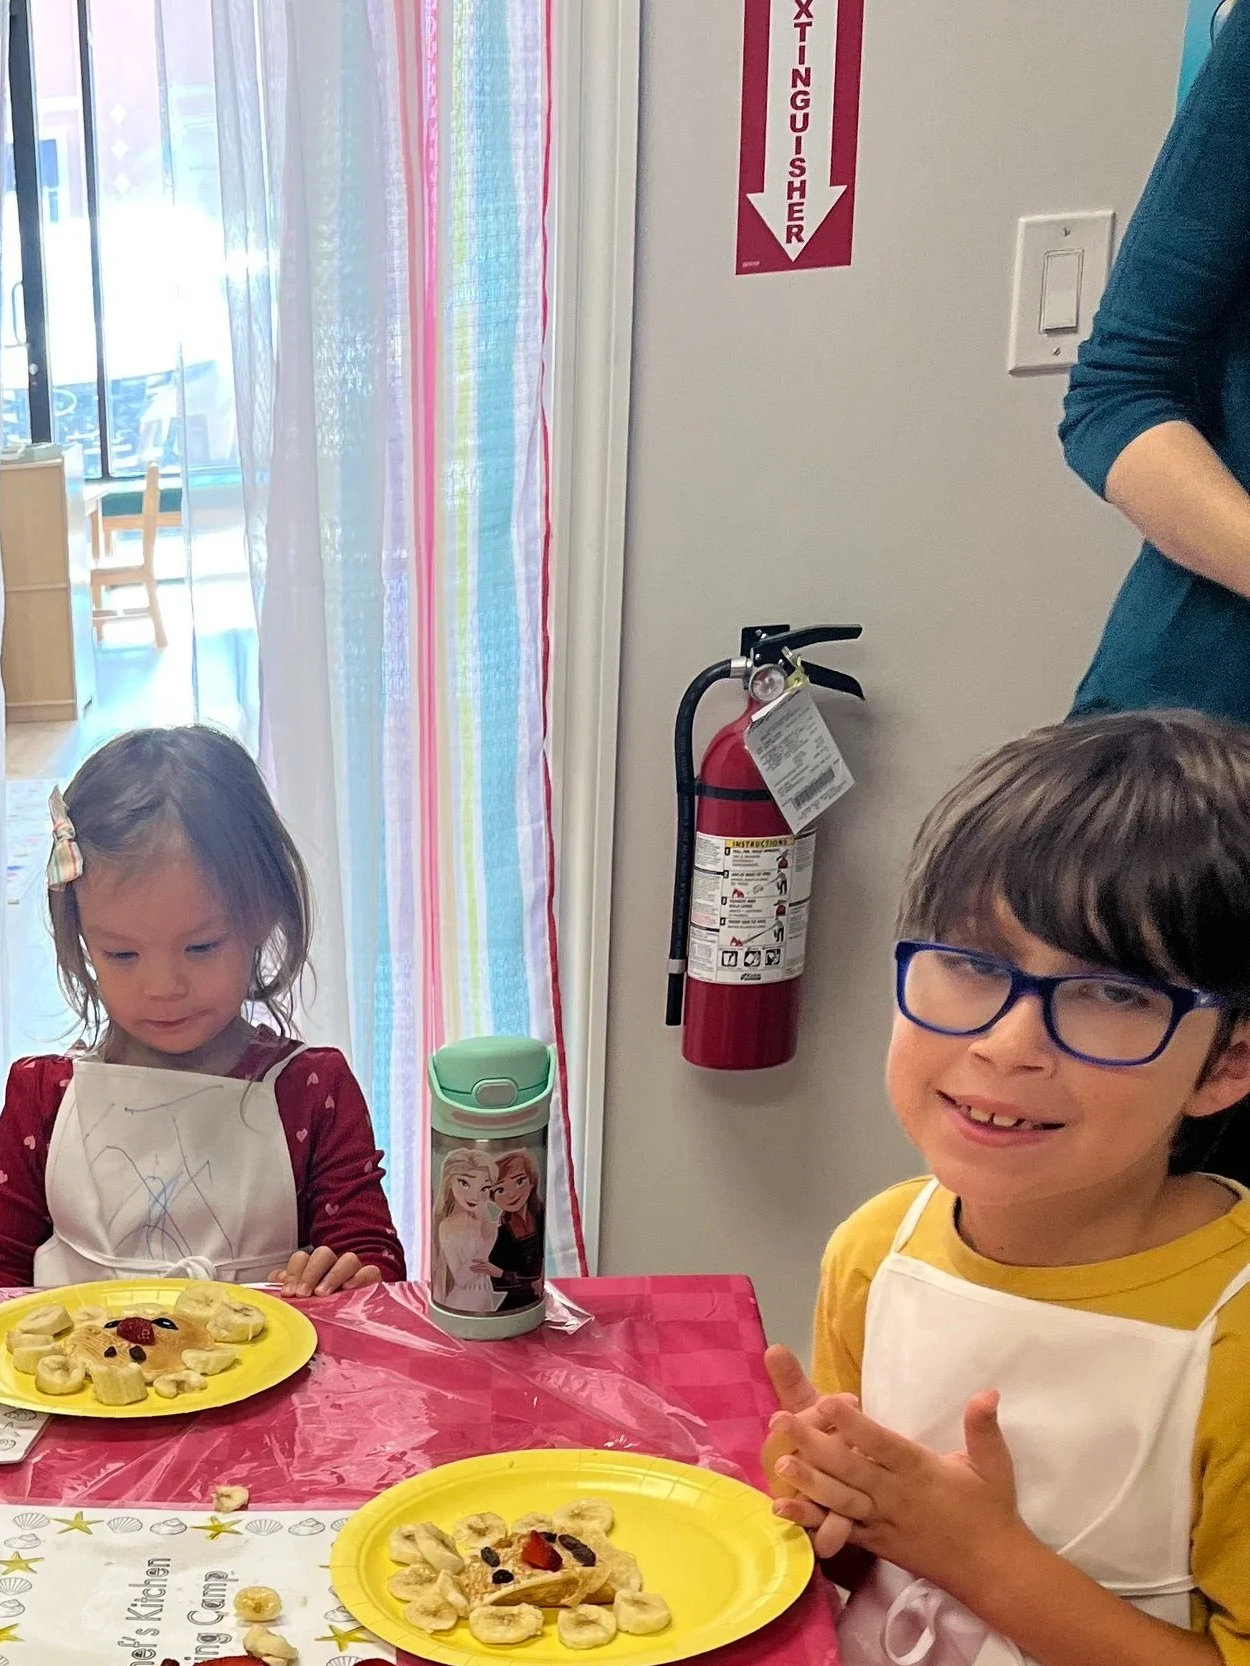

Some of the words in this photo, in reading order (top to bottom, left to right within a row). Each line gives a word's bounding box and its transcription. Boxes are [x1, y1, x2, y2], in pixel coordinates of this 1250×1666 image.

[784, 0, 814, 244] XTINGUISHER
[125, 1557, 171, 1621] Kitchen
[186, 1570, 239, 1626] Camp
